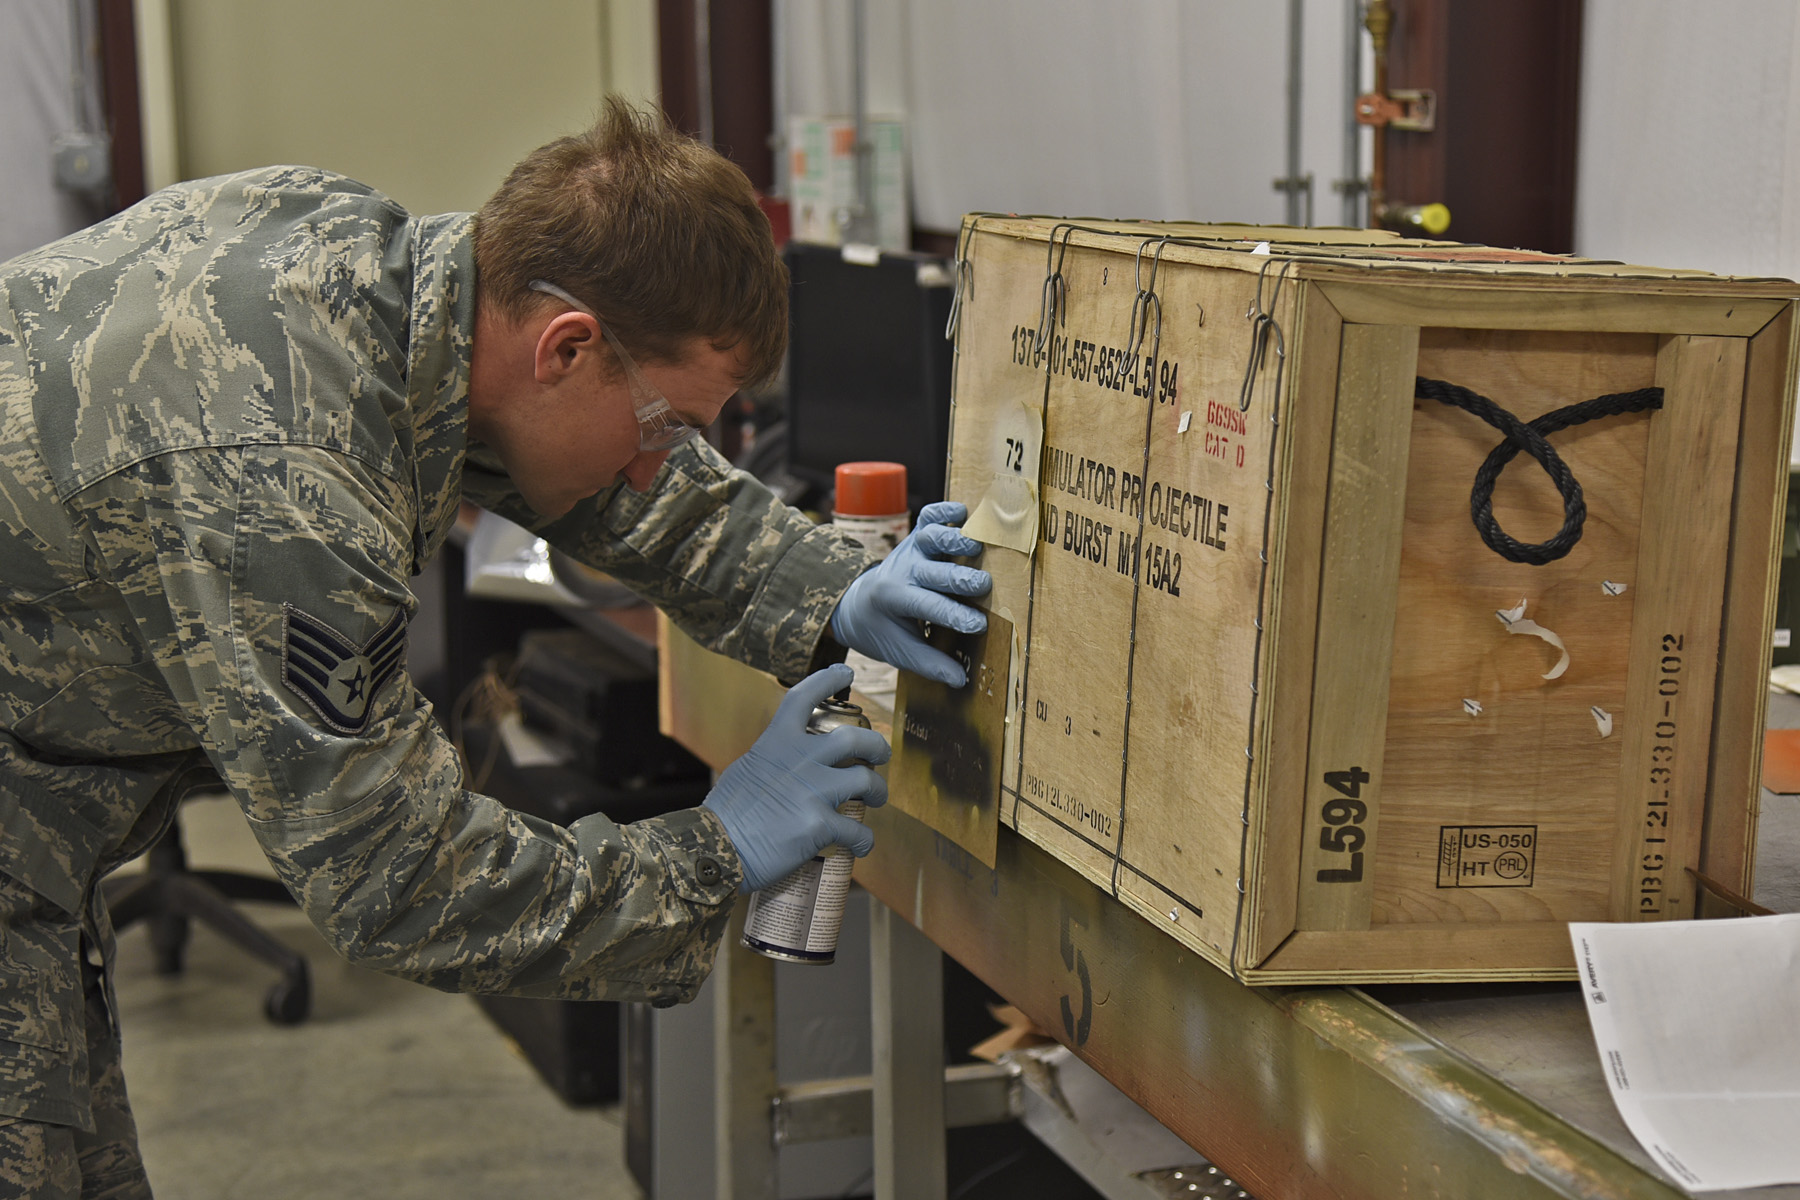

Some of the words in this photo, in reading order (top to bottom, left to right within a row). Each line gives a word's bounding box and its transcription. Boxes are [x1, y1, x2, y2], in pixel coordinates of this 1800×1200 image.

[1006, 437, 1024, 471] 72
[1043, 445, 1116, 510] IMULATOR
[1038, 501, 1059, 545] ND
[1063, 510, 1113, 567] BURST
[1316, 766, 1370, 884] L594
[1464, 833, 1533, 849] US-050
[1463, 861, 1490, 877] HT
[1498, 858, 1524, 871] PRL
